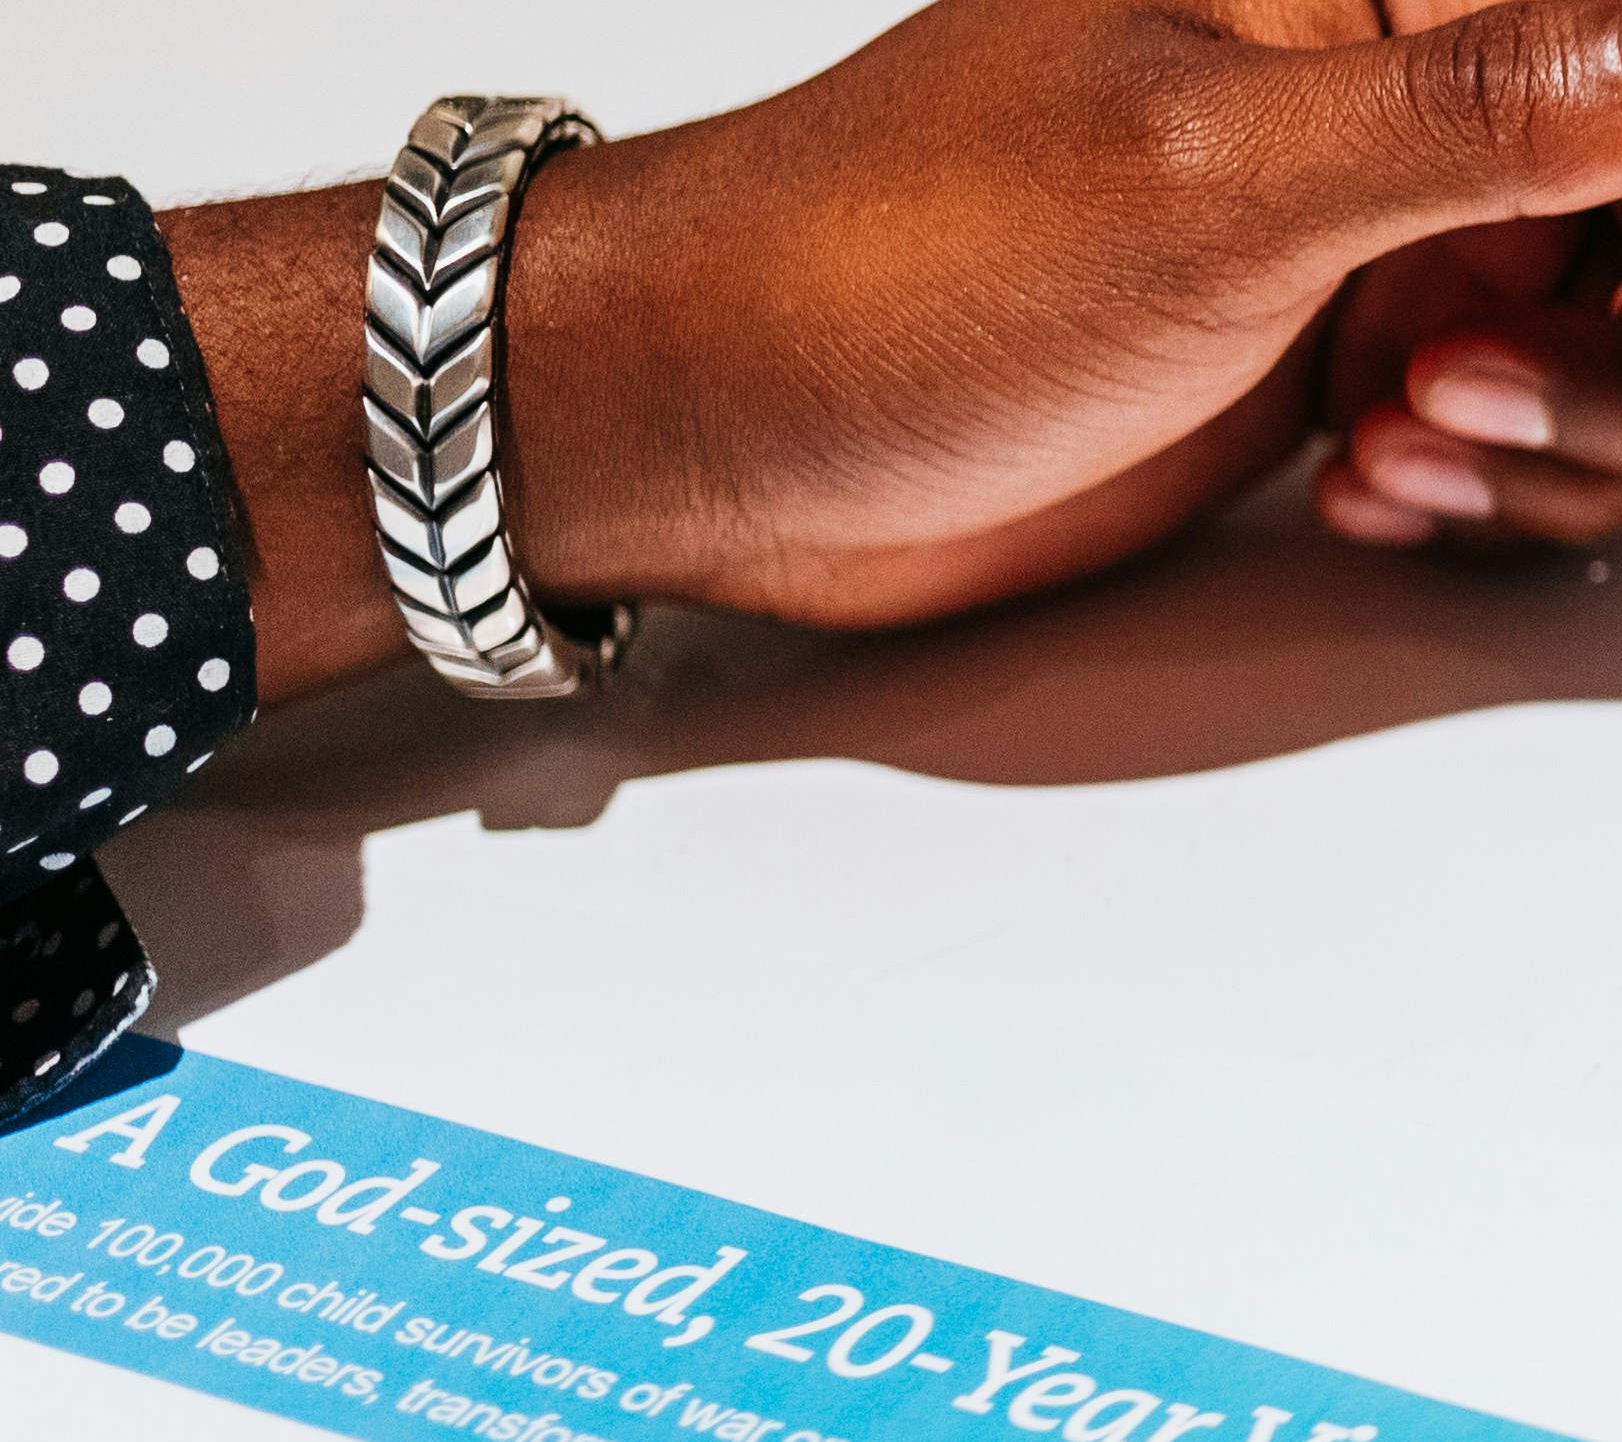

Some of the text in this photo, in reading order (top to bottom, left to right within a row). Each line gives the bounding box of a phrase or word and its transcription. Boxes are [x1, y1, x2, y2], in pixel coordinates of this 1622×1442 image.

[53, 1093, 182, 1169] A
[189, 1123, 749, 1348] God-sized,
[86, 1217, 285, 1296] 100,000
[277, 1279, 407, 1334] child
[394, 1316, 619, 1399] survivors
[619, 1382, 696, 1418] of
[70, 1280, 128, 1319] to
[124, 1295, 199, 1339] be
[195, 1317, 386, 1405] leaders,
